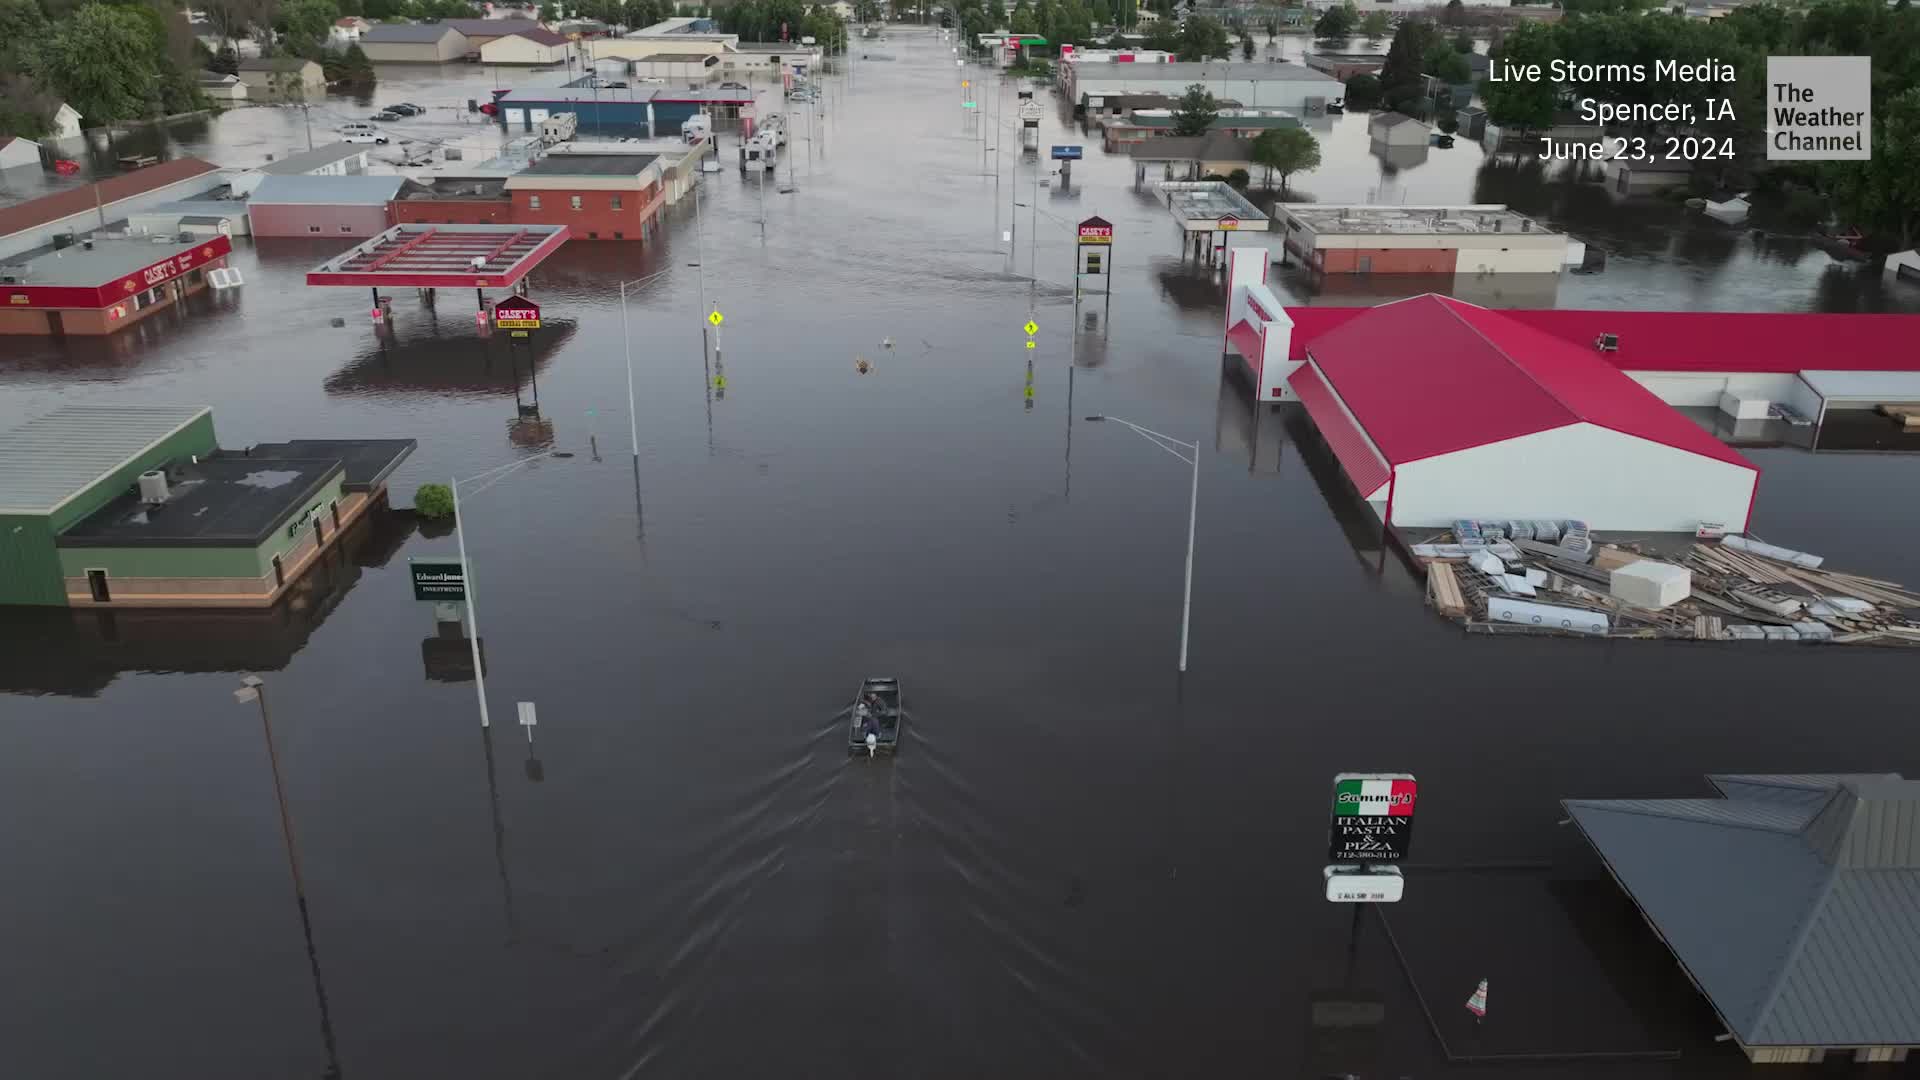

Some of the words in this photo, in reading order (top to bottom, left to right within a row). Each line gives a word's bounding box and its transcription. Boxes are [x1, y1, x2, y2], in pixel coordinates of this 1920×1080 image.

[1081, 227, 1110, 236] CASEY'S
[144, 260, 176, 285] CASEY'S
[499, 310, 537, 319] CASEY'S
[1339, 792, 1412, 806] Sammy's
[1337, 817, 1408, 825] ITALIAN
[1343, 826, 1396, 834] PASTA
[1362, 834, 1375, 843] &
[1345, 842, 1392, 850] PIZZA
